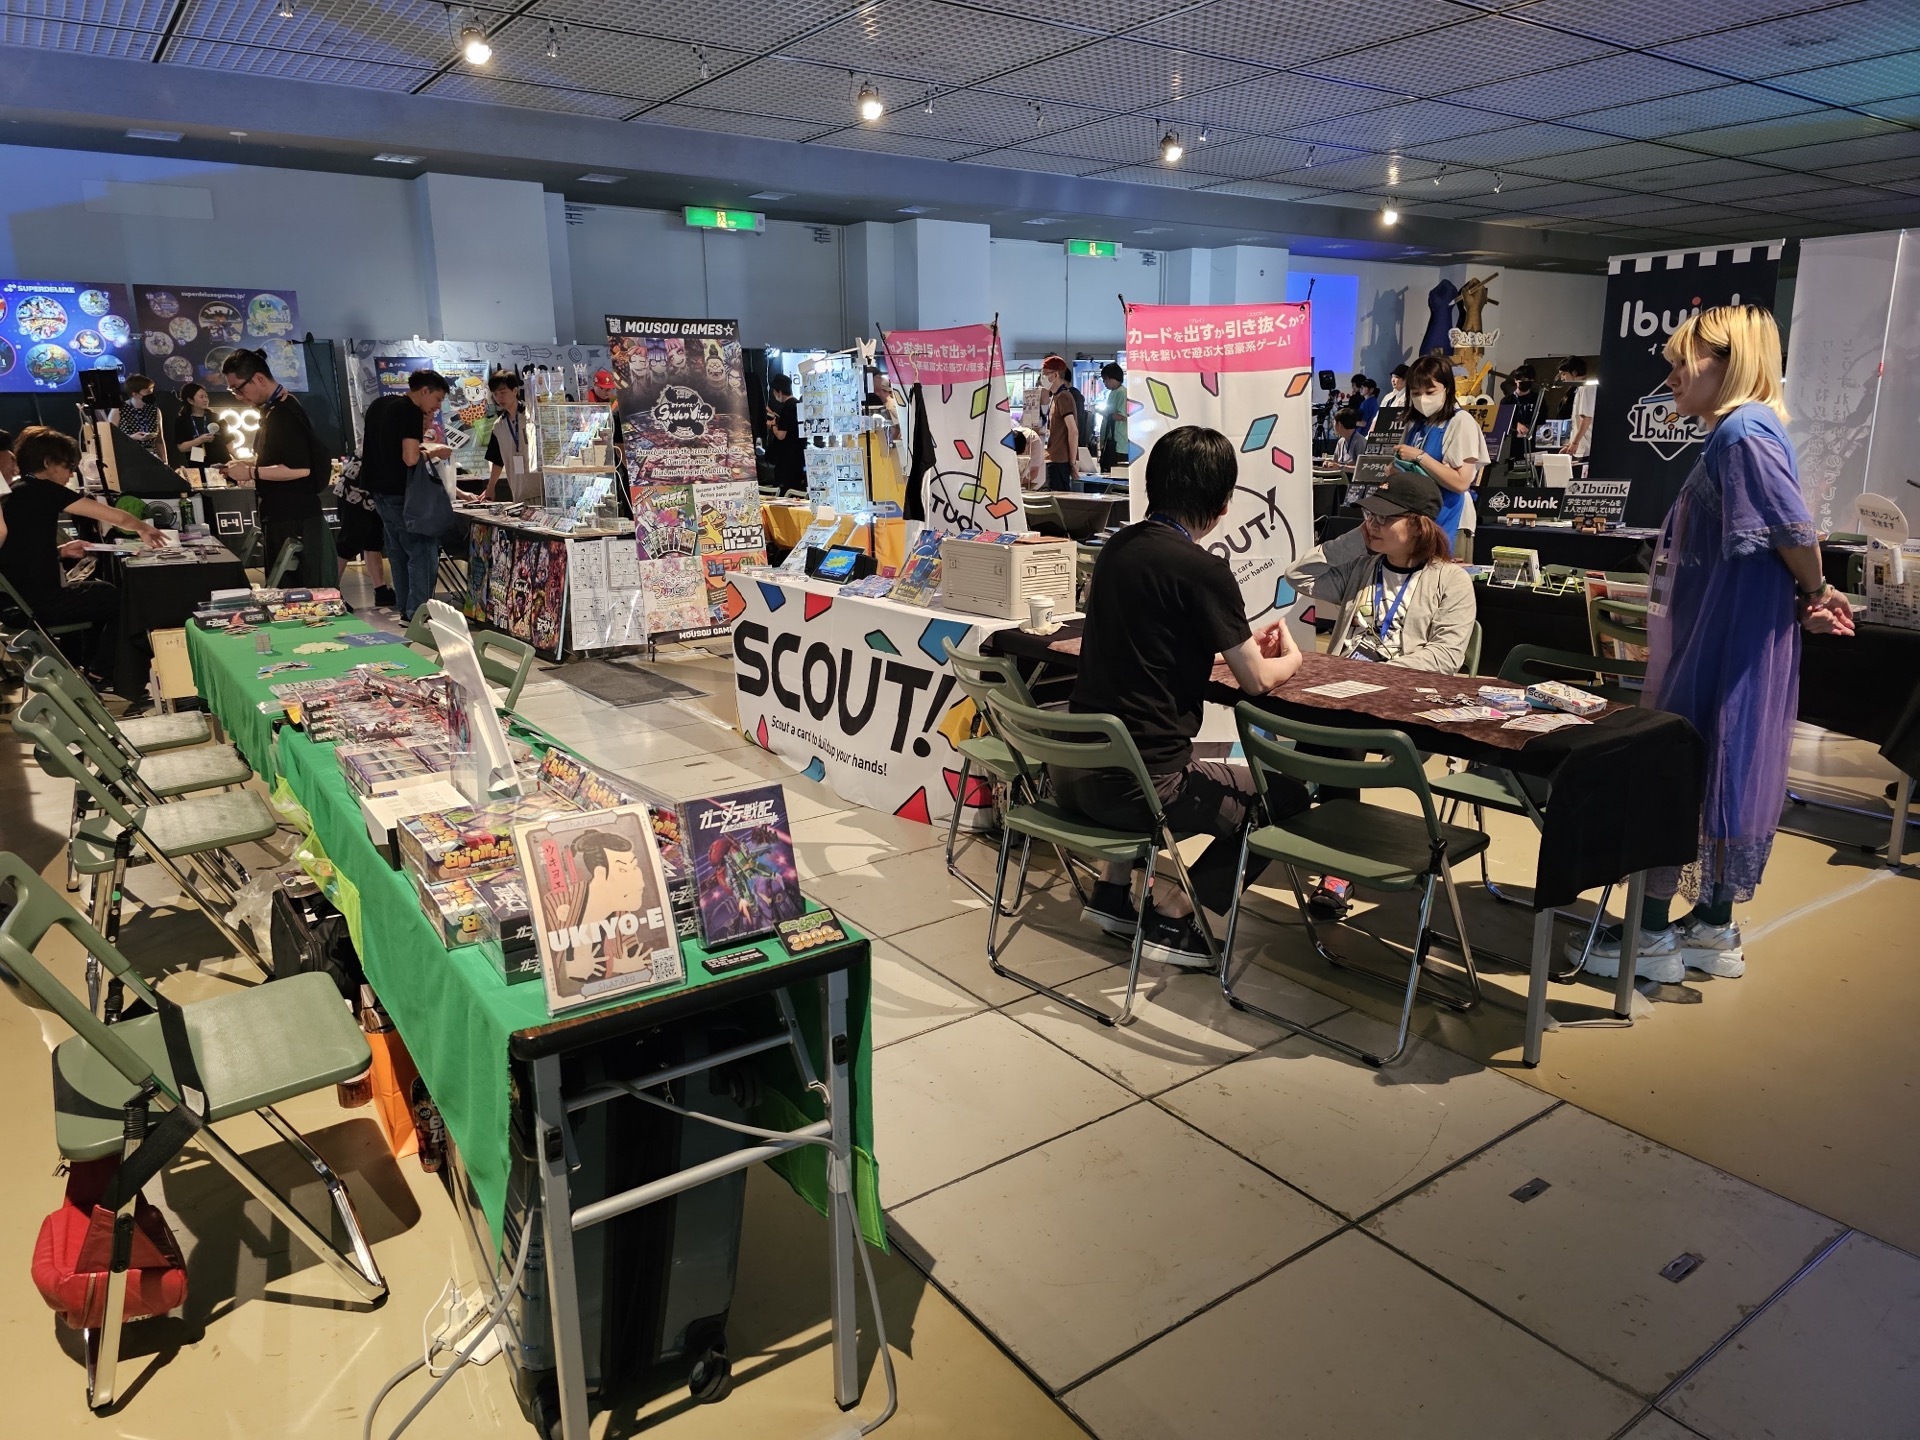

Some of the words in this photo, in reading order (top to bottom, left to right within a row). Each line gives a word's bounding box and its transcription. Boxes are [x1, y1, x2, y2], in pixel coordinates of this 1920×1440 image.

[17, 285, 75, 294] SUPERDELUXE
[625, 321, 679, 335] MOUSOU
[681, 323, 723, 336] GAMES
[1129, 313, 1307, 345] カードを出すか引き抜くか?
[1129, 334, 1292, 362] 手札を繋いで遊ぶ大富豪系ゲーム!
[1632, 404, 1702, 440] Ibuink
[1514, 495, 1559, 510] Ibuink
[1581, 483, 1629, 495] Ibuink
[1208, 486, 1278, 560] OUT!
[1237, 561, 1254, 575] card
[1237, 574, 1251, 585] our
[1251, 558, 1275, 577] hands!
[679, 626, 712, 639] MOUSOU
[733, 619, 957, 758] SCOUT!
[771, 715, 789, 735] Scout
[790, 727, 796, 735] a
[836, 748, 852, 766] your
[852, 755, 888, 777] hands!
[545, 845, 565, 890] ツキヨエ
[548, 907, 666, 952] UKIYO-E
